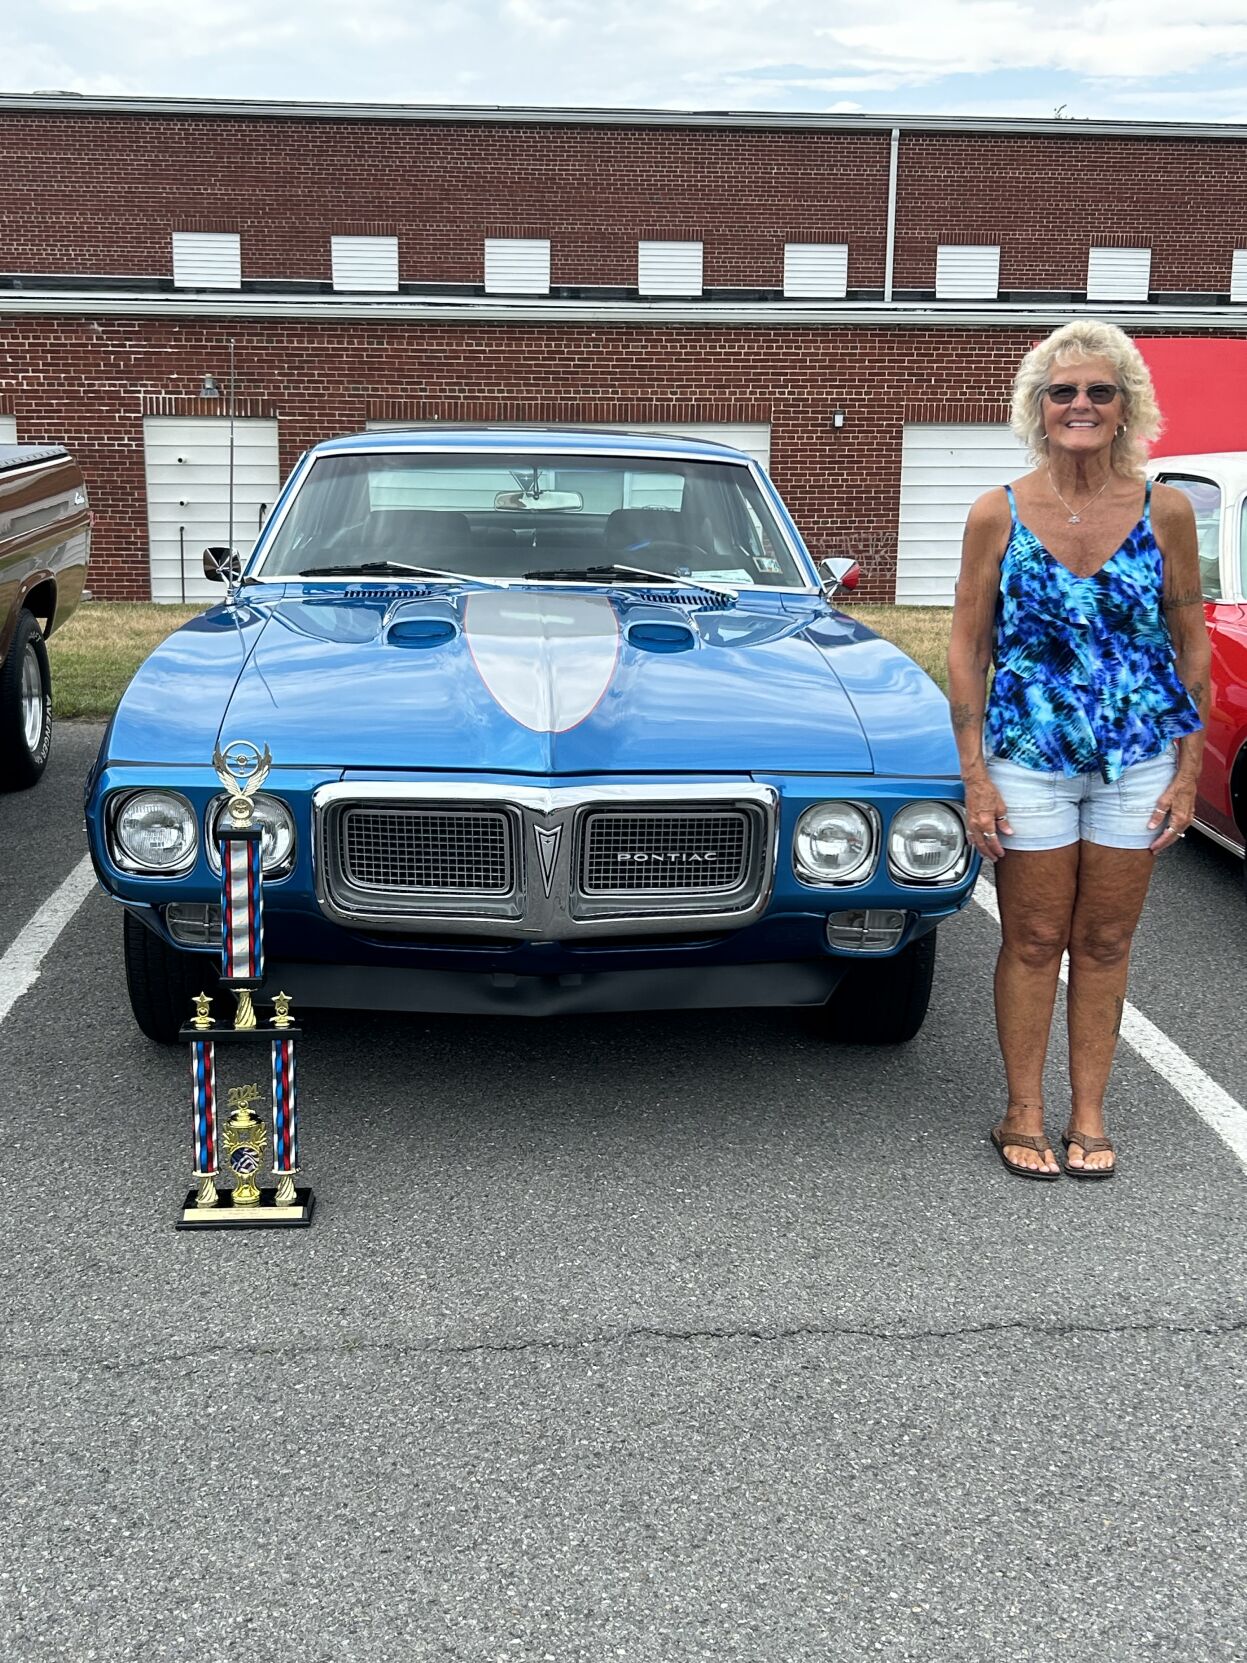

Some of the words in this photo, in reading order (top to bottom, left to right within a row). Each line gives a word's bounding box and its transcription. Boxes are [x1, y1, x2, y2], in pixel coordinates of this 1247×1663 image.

[41, 694, 52, 760] AVENGER
[617, 852, 717, 862] PONTIAC
[228, 1083, 259, 1102] 2024
